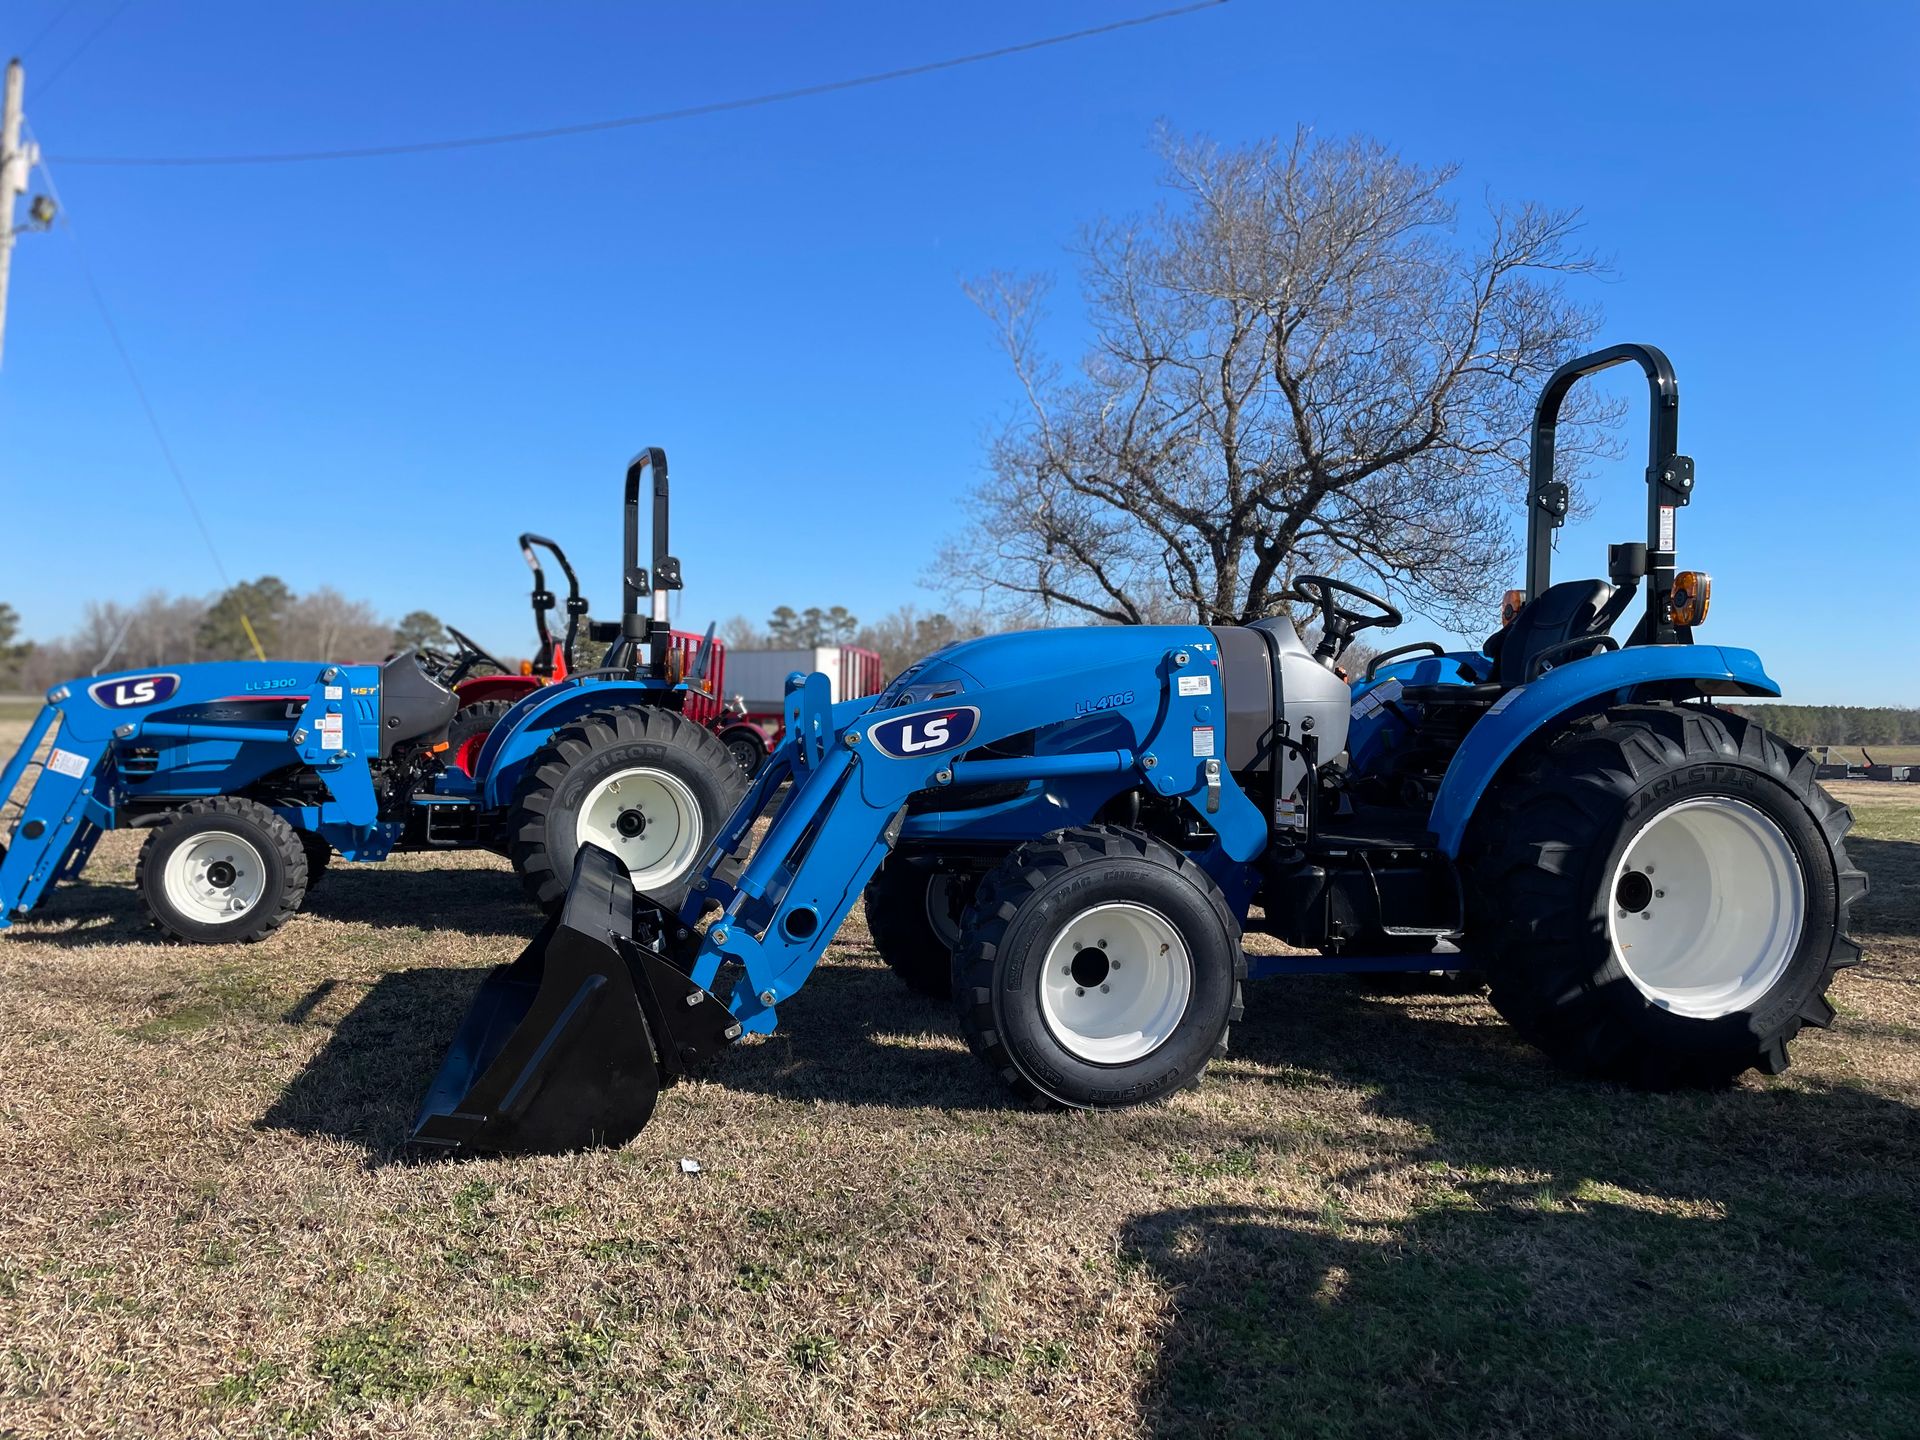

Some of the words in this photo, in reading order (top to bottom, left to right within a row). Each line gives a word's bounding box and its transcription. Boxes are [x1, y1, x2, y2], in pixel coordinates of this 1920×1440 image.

[115, 680, 156, 706] LS
[245, 678, 297, 691] LL3300
[350, 687, 377, 695] HST
[1076, 690, 1134, 714] LL4106
[901, 718, 950, 753] LS
[583, 746, 664, 775] TIRON
